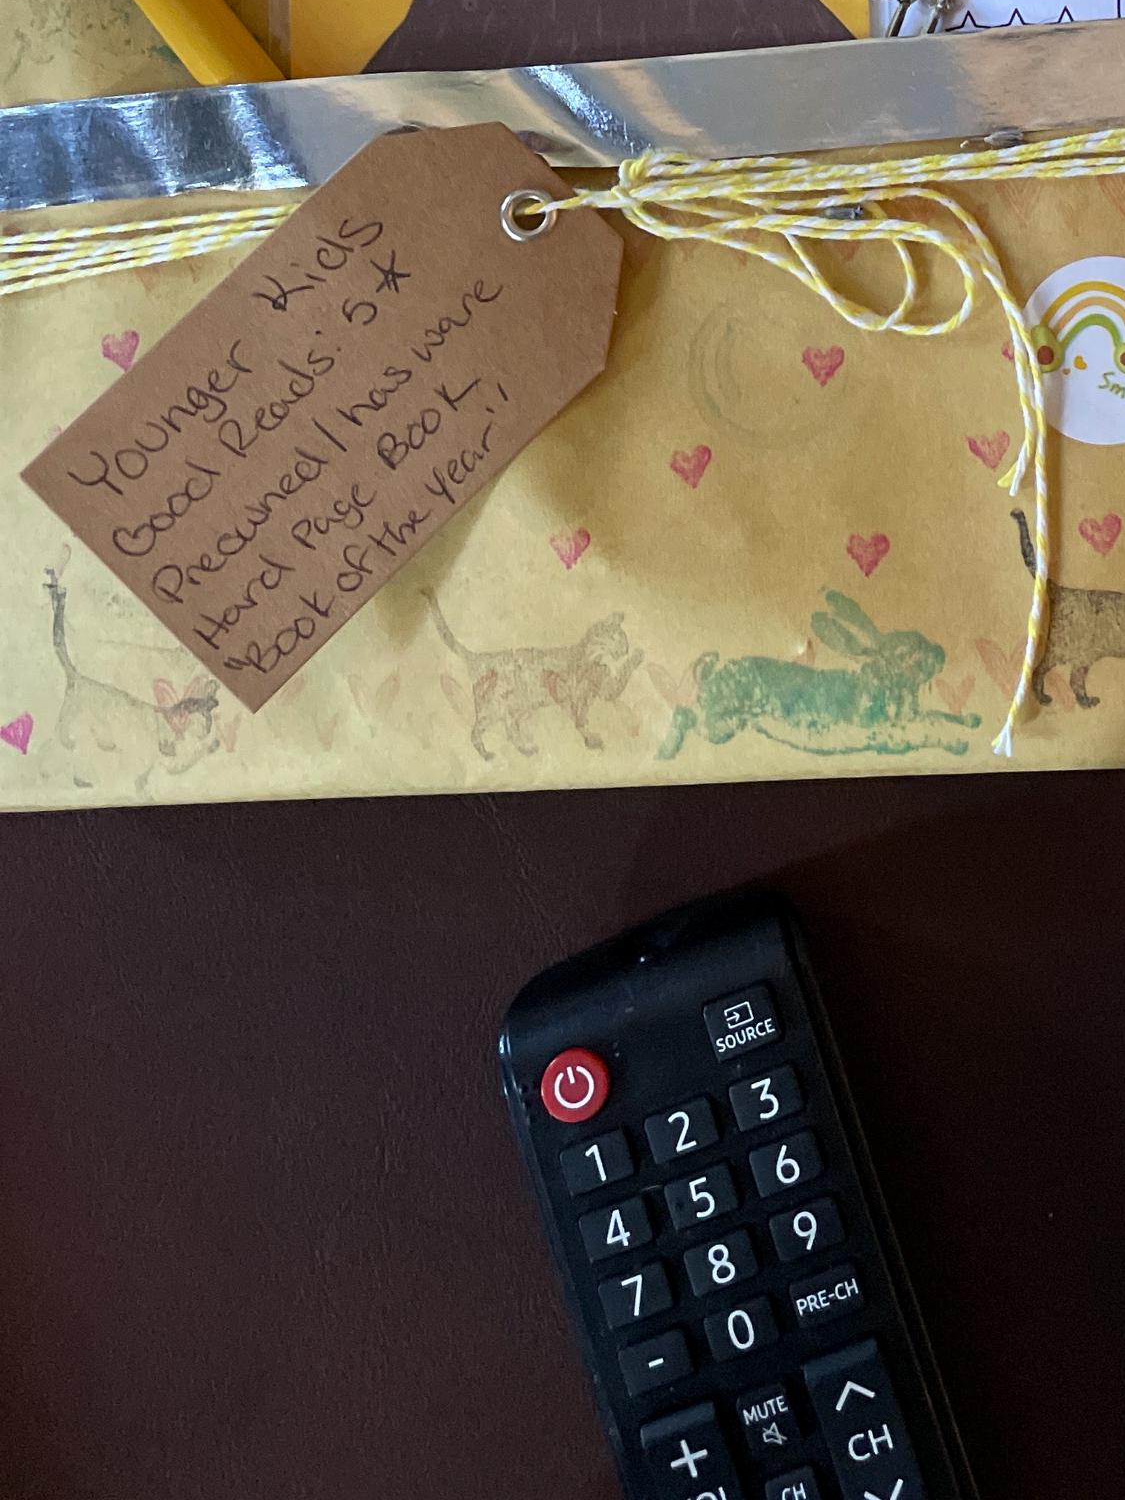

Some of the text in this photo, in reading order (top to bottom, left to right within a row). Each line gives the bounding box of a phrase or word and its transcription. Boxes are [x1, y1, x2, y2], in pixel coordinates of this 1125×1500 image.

[69, 214, 384, 497] Younger Kids
[412, 279, 502, 363] ware
[112, 463, 222, 558] Good
[337, 548, 374, 593] of
[371, 506, 432, 558] the
[192, 559, 297, 649] Hard
[291, 480, 376, 550] Page
[715, 1016, 776, 1054] SOURCE
[585, 1077, 780, 1182] 1 2 3
[606, 1144, 801, 1247] 4 5 6
[621, 1211, 818, 1316] 7 8 9
[727, 1310, 755, 1350] 0
[796, 1277, 860, 1317] PRE-CH
[742, 1395, 788, 1426] MUTE
[848, 1424, 893, 1462] CH
